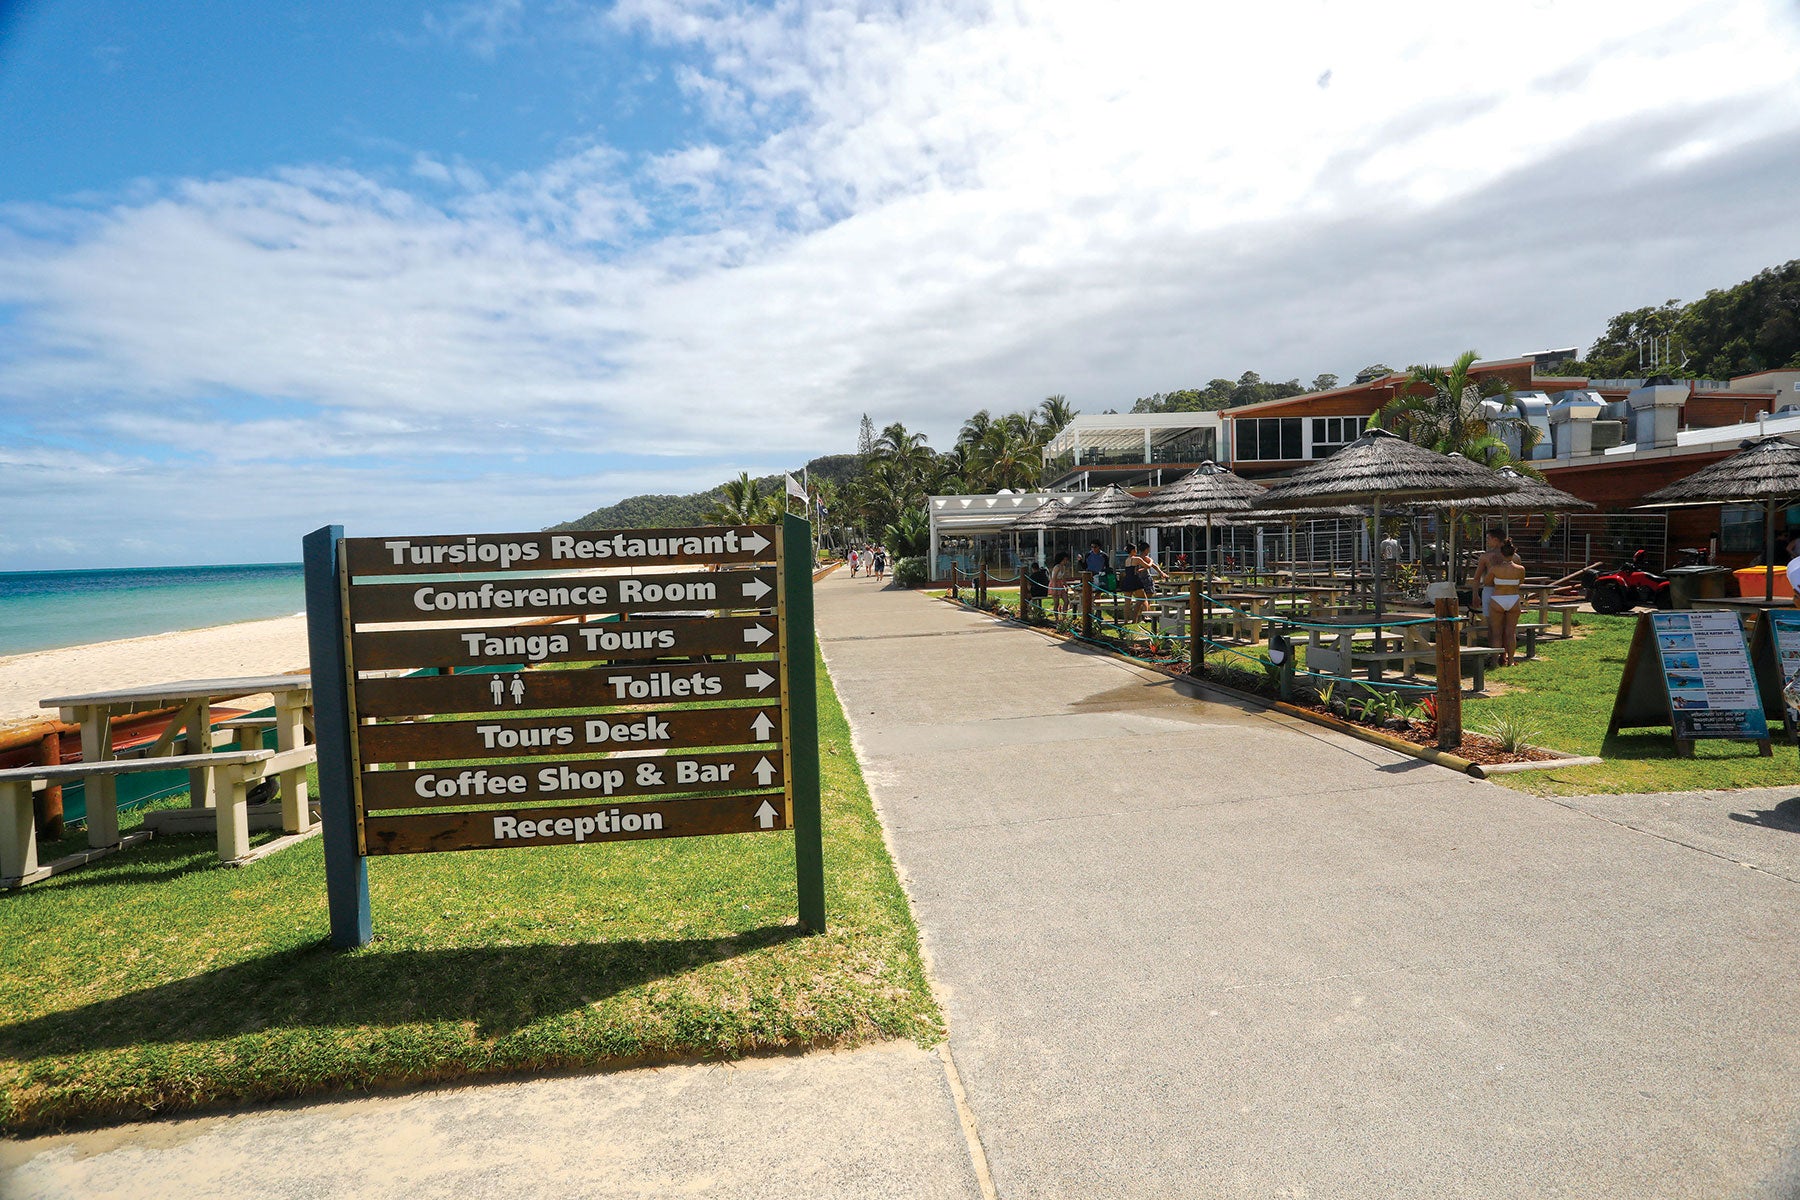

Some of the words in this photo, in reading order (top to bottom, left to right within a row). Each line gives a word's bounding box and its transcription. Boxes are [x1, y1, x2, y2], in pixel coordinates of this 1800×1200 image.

[385, 537, 541, 568] Tursiops
[551, 529, 739, 560] Restaurant
[413, 583, 608, 612] Conference
[619, 580, 716, 603] Room
[461, 633, 569, 661] Tanga
[579, 627, 675, 652] Tours
[608, 671, 722, 699] Toilets
[476, 725, 574, 749] Tours
[585, 716, 670, 743] Desk
[414, 770, 527, 799] Coffee
[538, 766, 624, 795] Shop
[635, 763, 665, 786] &
[676, 760, 735, 784] Bar
[493, 808, 663, 842] Reception
